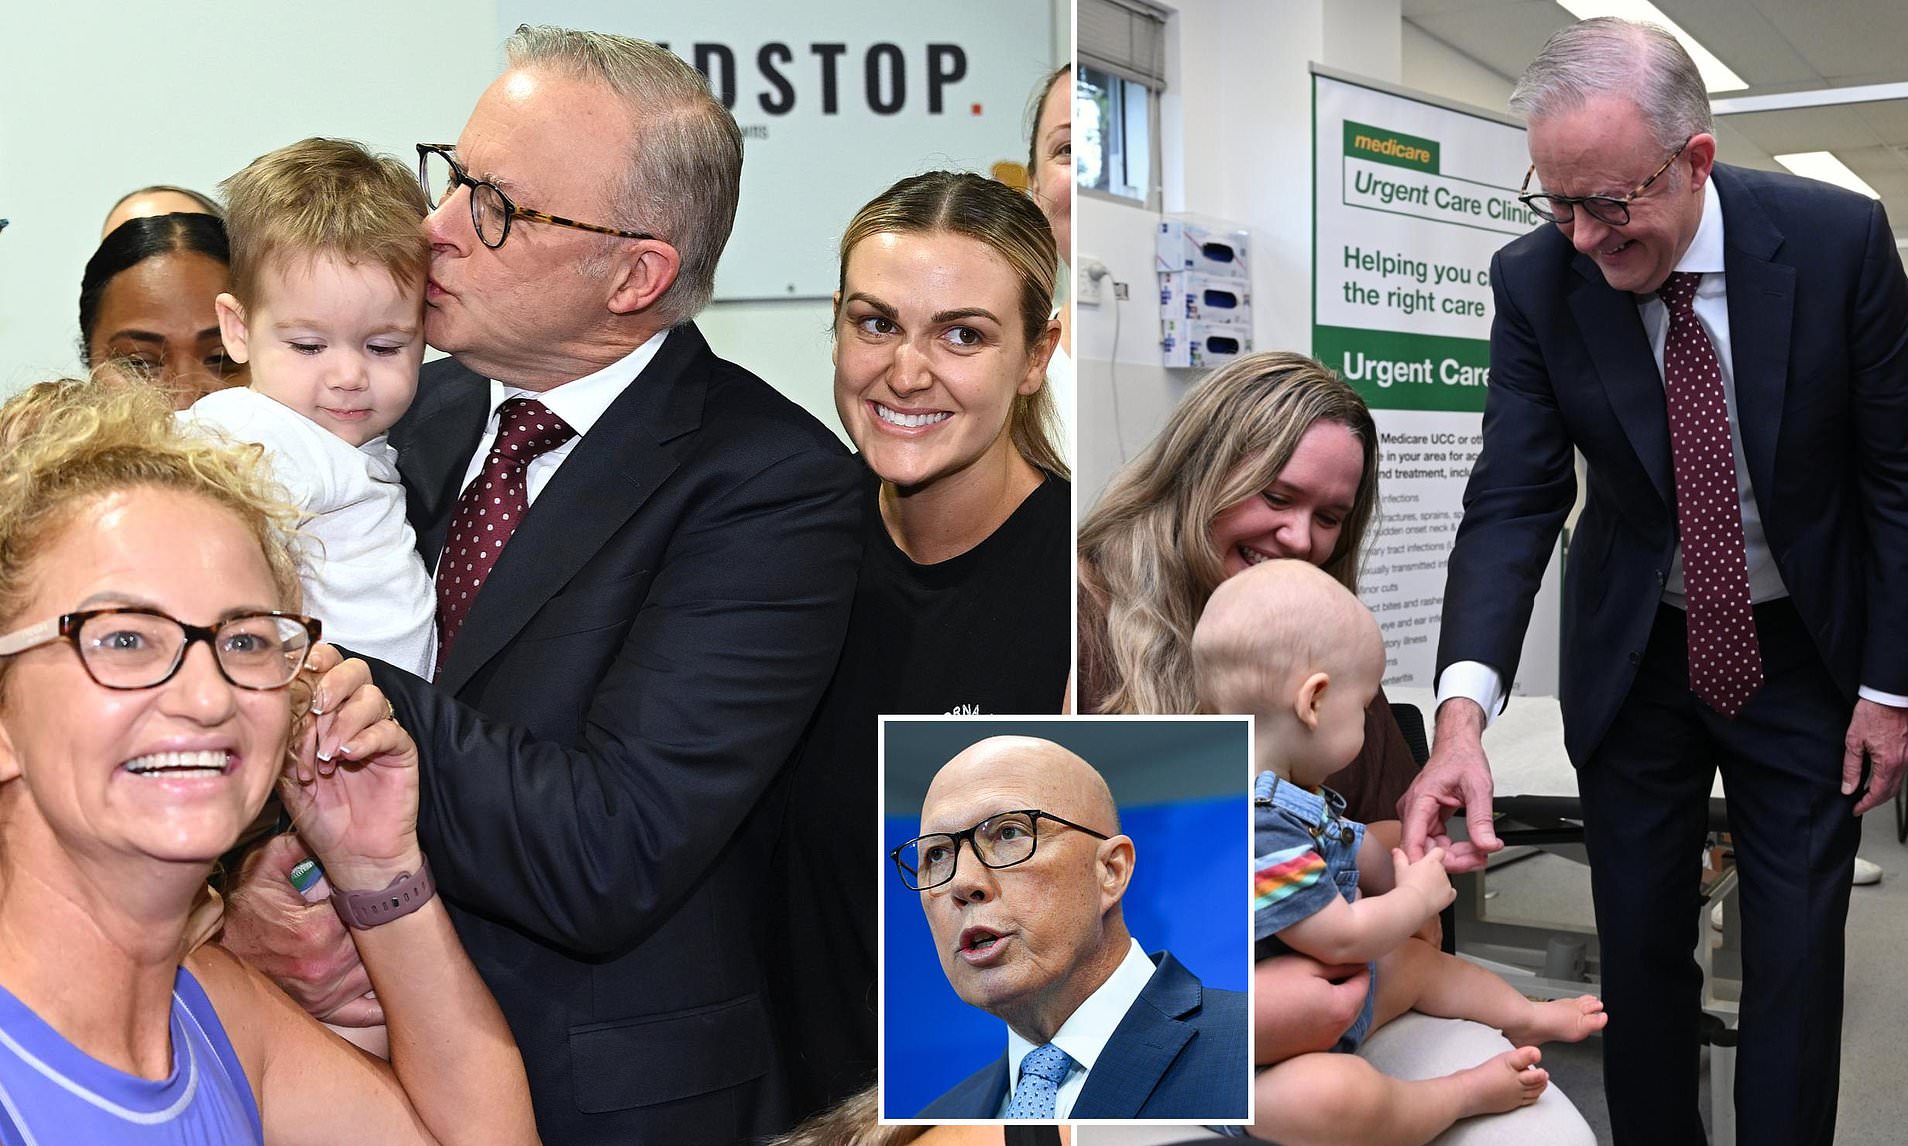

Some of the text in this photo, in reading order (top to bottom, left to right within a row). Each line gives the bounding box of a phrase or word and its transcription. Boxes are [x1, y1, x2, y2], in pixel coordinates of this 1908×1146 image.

[655, 43, 982, 116] DSTOP.
[1354, 134, 1431, 164] medicare
[1354, 170, 1538, 226] Urgent Care Clinic
[1344, 245, 1428, 284] Helping
[1433, 264, 1472, 285] you
[1343, 281, 1486, 318] the right care
[1343, 351, 1490, 388] Urgent Care
[1380, 433, 1428, 445] Medicare
[1431, 434, 1455, 445] UCC
[1459, 435, 1469, 445] or
[1387, 452, 1397, 462] in
[1399, 454, 1421, 464] your
[1423, 453, 1447, 462] area
[1449, 451, 1461, 461] for
[1395, 469, 1447, 479] treatment,
